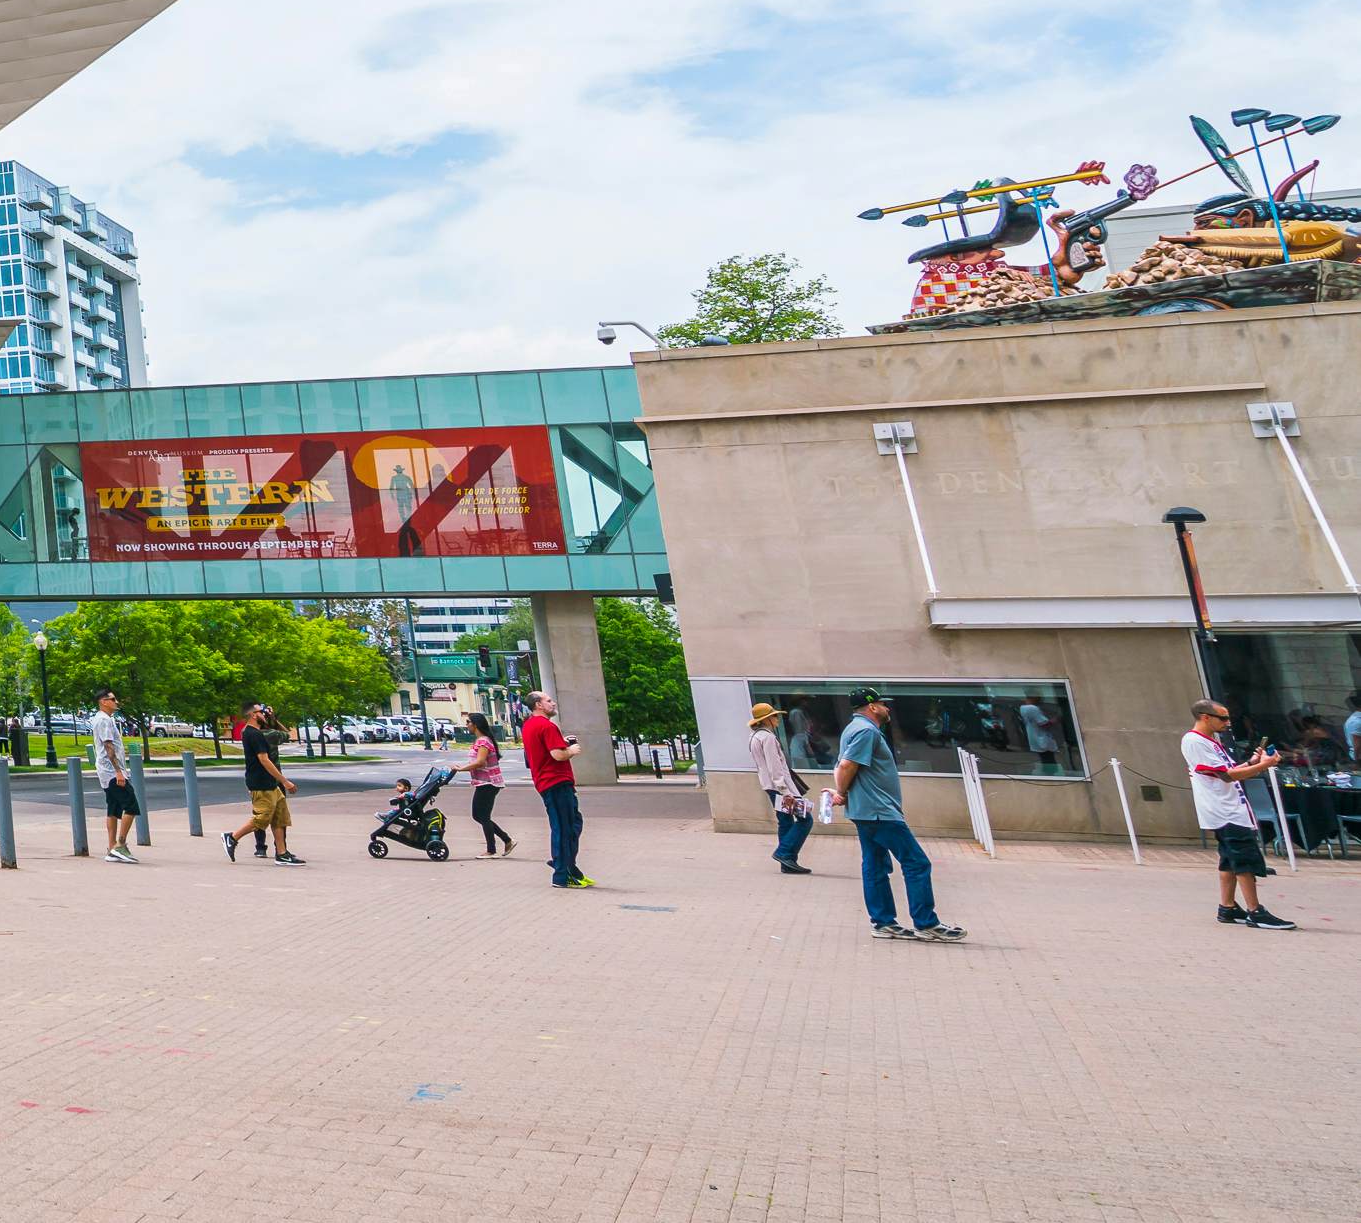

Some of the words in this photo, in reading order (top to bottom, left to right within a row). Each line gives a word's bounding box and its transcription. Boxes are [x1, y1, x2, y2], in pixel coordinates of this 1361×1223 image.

[148, 453, 172, 462] ART
[181, 468, 237, 481] THE
[95, 480, 334, 509] WESTERN
[456, 488, 462, 496] A
[464, 487, 485, 496] TOUR
[488, 487, 498, 495] DE
[501, 486, 529, 494] FORCE
[460, 498, 470, 506] ON
[473, 497, 507, 505] CANVAS
[508, 496, 527, 504] AND
[459, 508, 468, 516] IN
[473, 506, 531, 515] TECHNICOLOR
[157, 519, 172, 528] AN
[175, 519, 199, 527] EPIC
[202, 518, 213, 527] IN
[216, 518, 238, 526] ART
[250, 517, 275, 526] FILM
[116, 543, 141, 552] NOW
[143, 542, 195, 552] SHOWING
[197, 541, 251, 551] THROUGH
[253, 540, 319, 550] SEPTEMBER
[321, 540, 334, 549] 10
